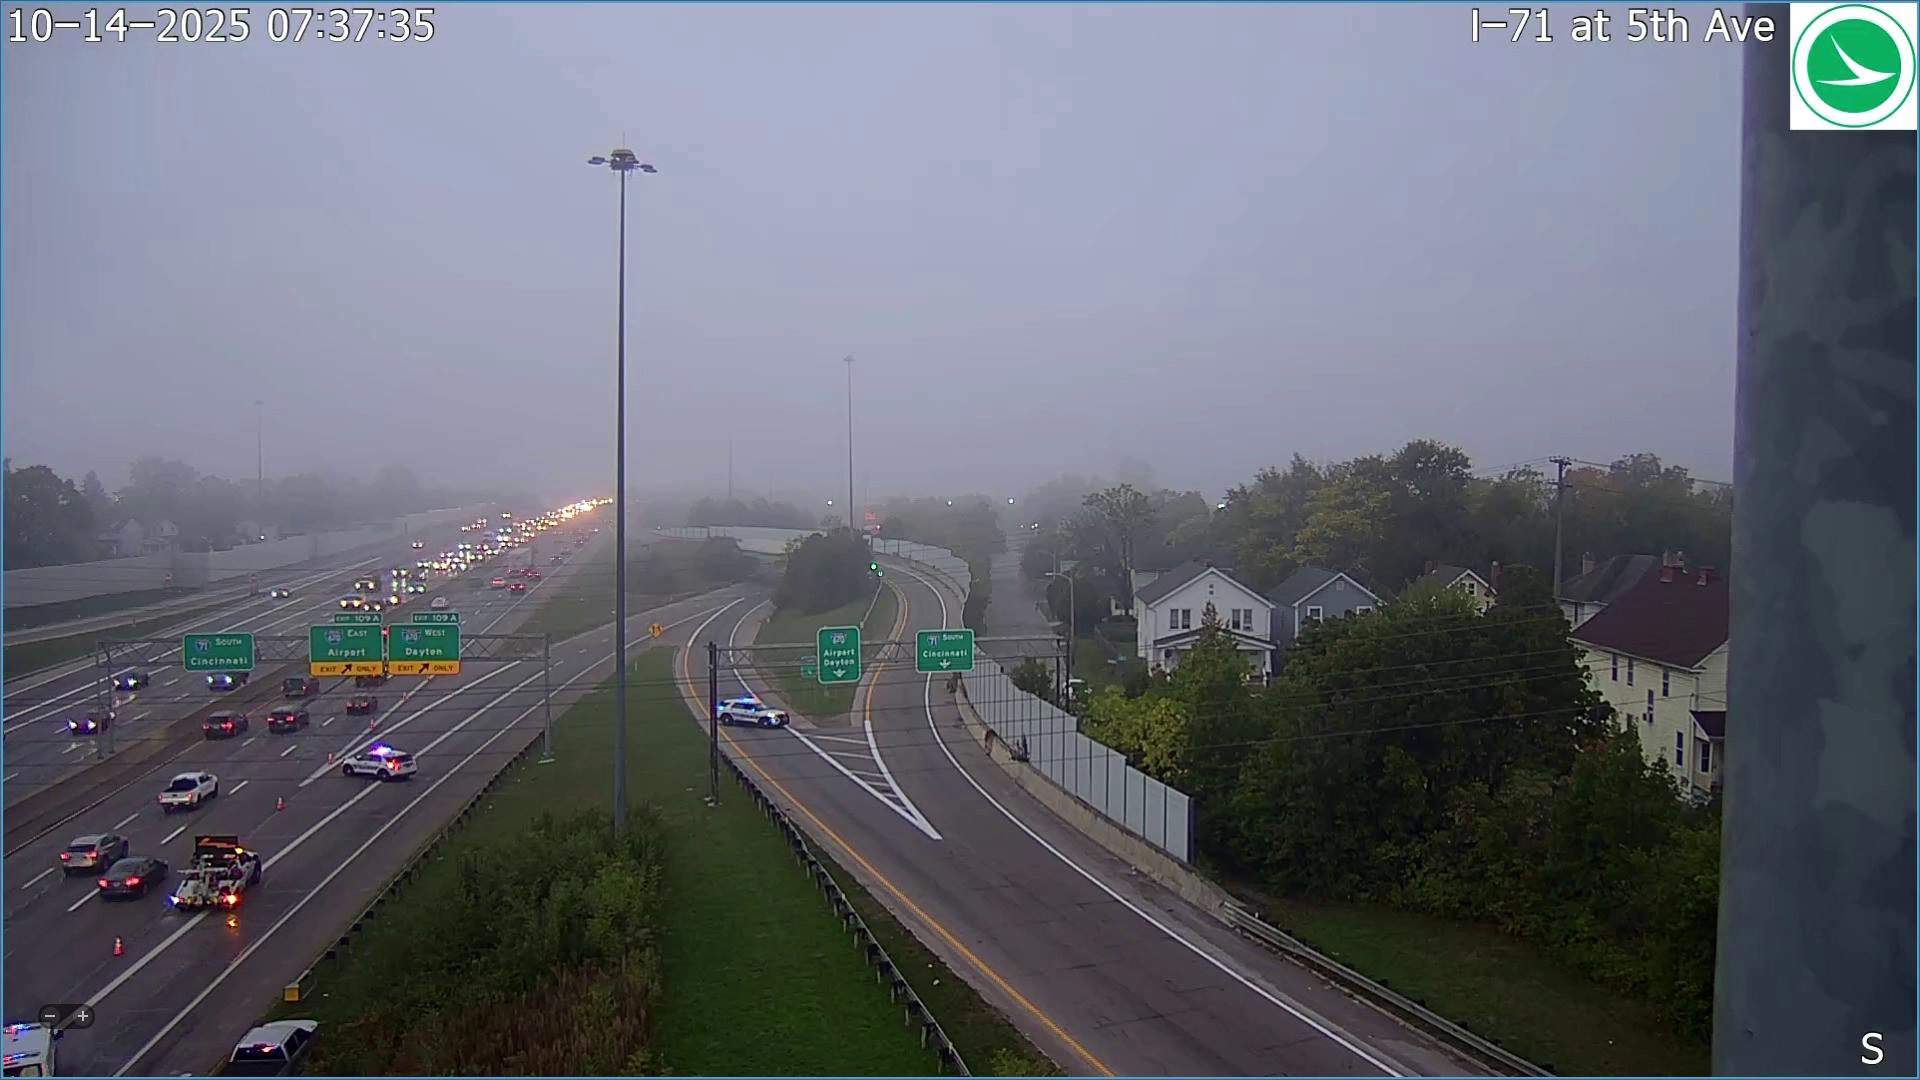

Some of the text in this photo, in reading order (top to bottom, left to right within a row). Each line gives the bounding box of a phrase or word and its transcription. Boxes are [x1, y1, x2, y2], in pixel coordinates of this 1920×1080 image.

[450, 614, 458, 622] A
[347, 629, 368, 637] EAST
[424, 629, 446, 637] WEST
[215, 638, 242, 646] SOUTH
[328, 648, 366, 658] Airport
[405, 647, 443, 657] Dayton
[823, 648, 855, 657] Airport
[922, 650, 968, 658] Cincinnati
[190, 656, 248, 666] Cincinnati
[823, 659, 855, 668] Dayton
[433, 664, 454, 672] ONLY
